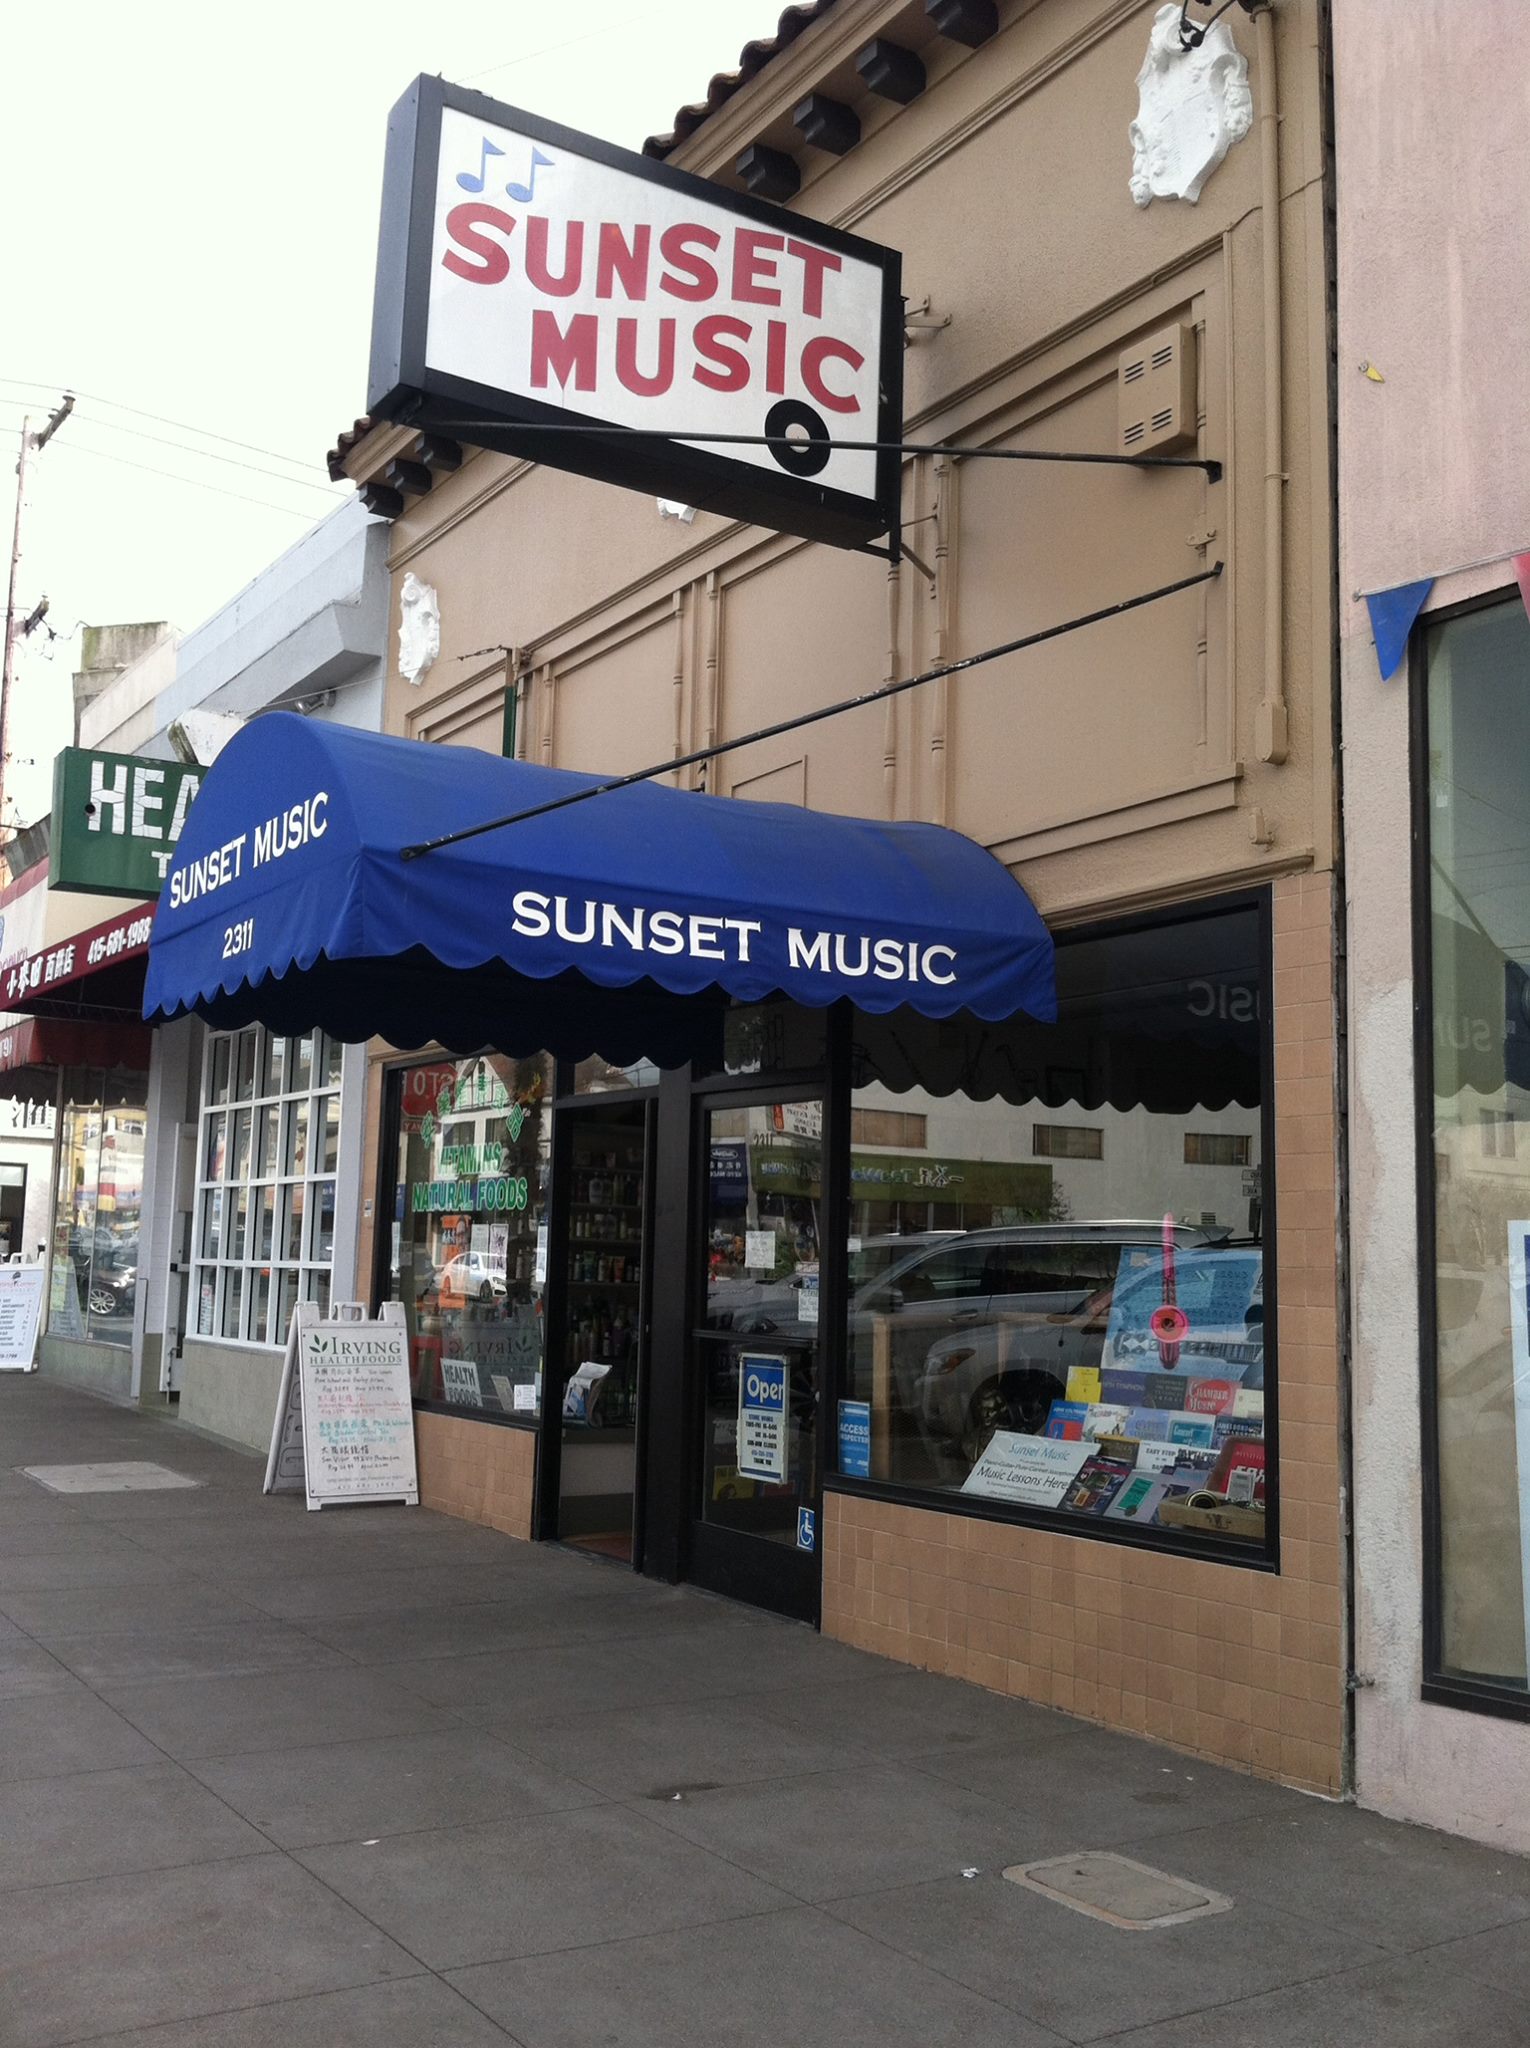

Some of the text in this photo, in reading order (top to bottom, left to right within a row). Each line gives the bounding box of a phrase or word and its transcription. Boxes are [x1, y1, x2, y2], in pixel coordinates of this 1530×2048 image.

[441, 202, 842, 319] SUNSET
[530, 309, 866, 414] MUSIC
[169, 791, 329, 909] SUNSET MUSIC
[221, 917, 255, 960] 2311
[511, 890, 957, 984] SUNSET MUSIC
[439, 1141, 503, 1175] VITAMINS
[412, 1176, 528, 1212] NATURAL FOODS
[331, 1336, 401, 1355] IRVING
[444, 1364, 476, 1387] HEALTH
[839, 1422, 868, 1436] ACCESS
[1008, 1441, 1071, 1461] Sunset Music
[977, 1465, 1006, 1480] Music
[1006, 1470, 1042, 1486] Lessons
